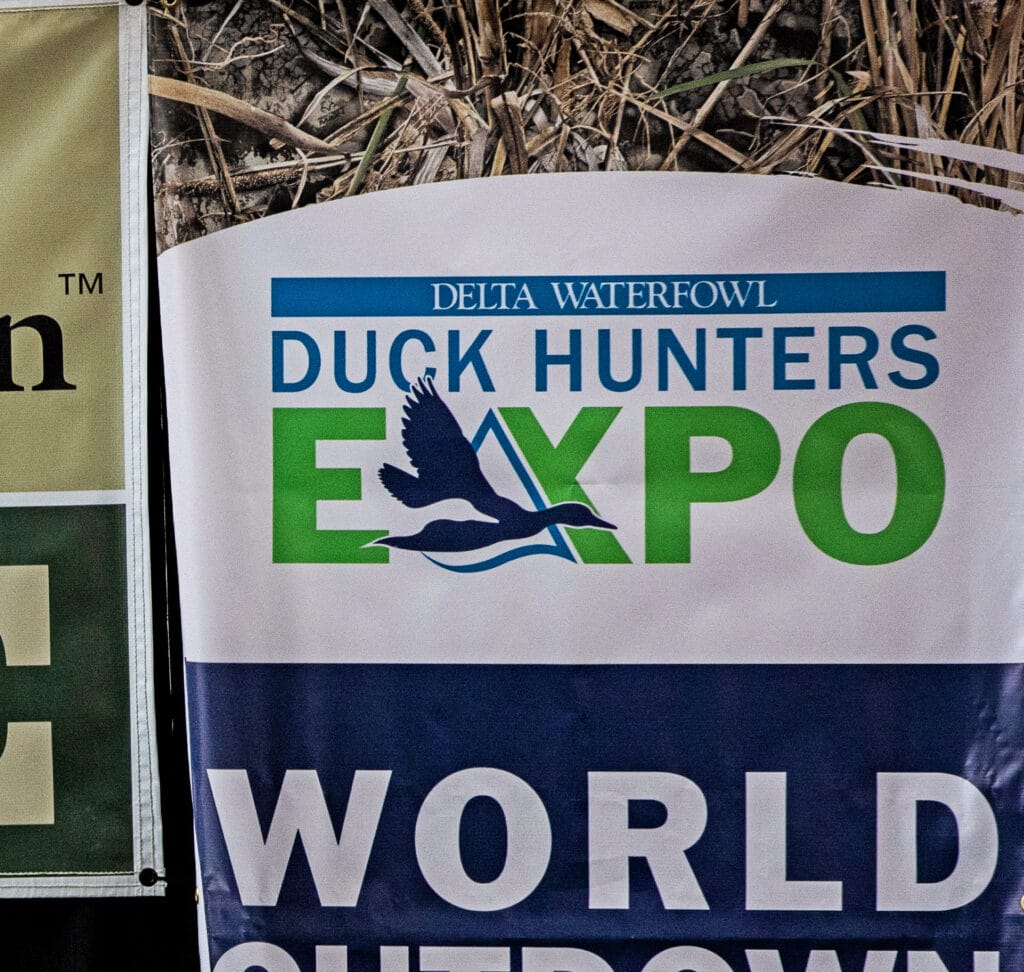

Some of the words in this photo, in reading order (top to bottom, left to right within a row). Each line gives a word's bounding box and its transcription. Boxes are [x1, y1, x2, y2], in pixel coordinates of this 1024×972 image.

[432, 282, 539, 311] DELTA
[551, 280, 778, 310] WATERFOWL
[271, 329, 496, 394] DUCK
[534, 324, 941, 393] HUNTERS
[272, 401, 946, 566] EXPO
[206, 766, 1000, 912] WORLD
